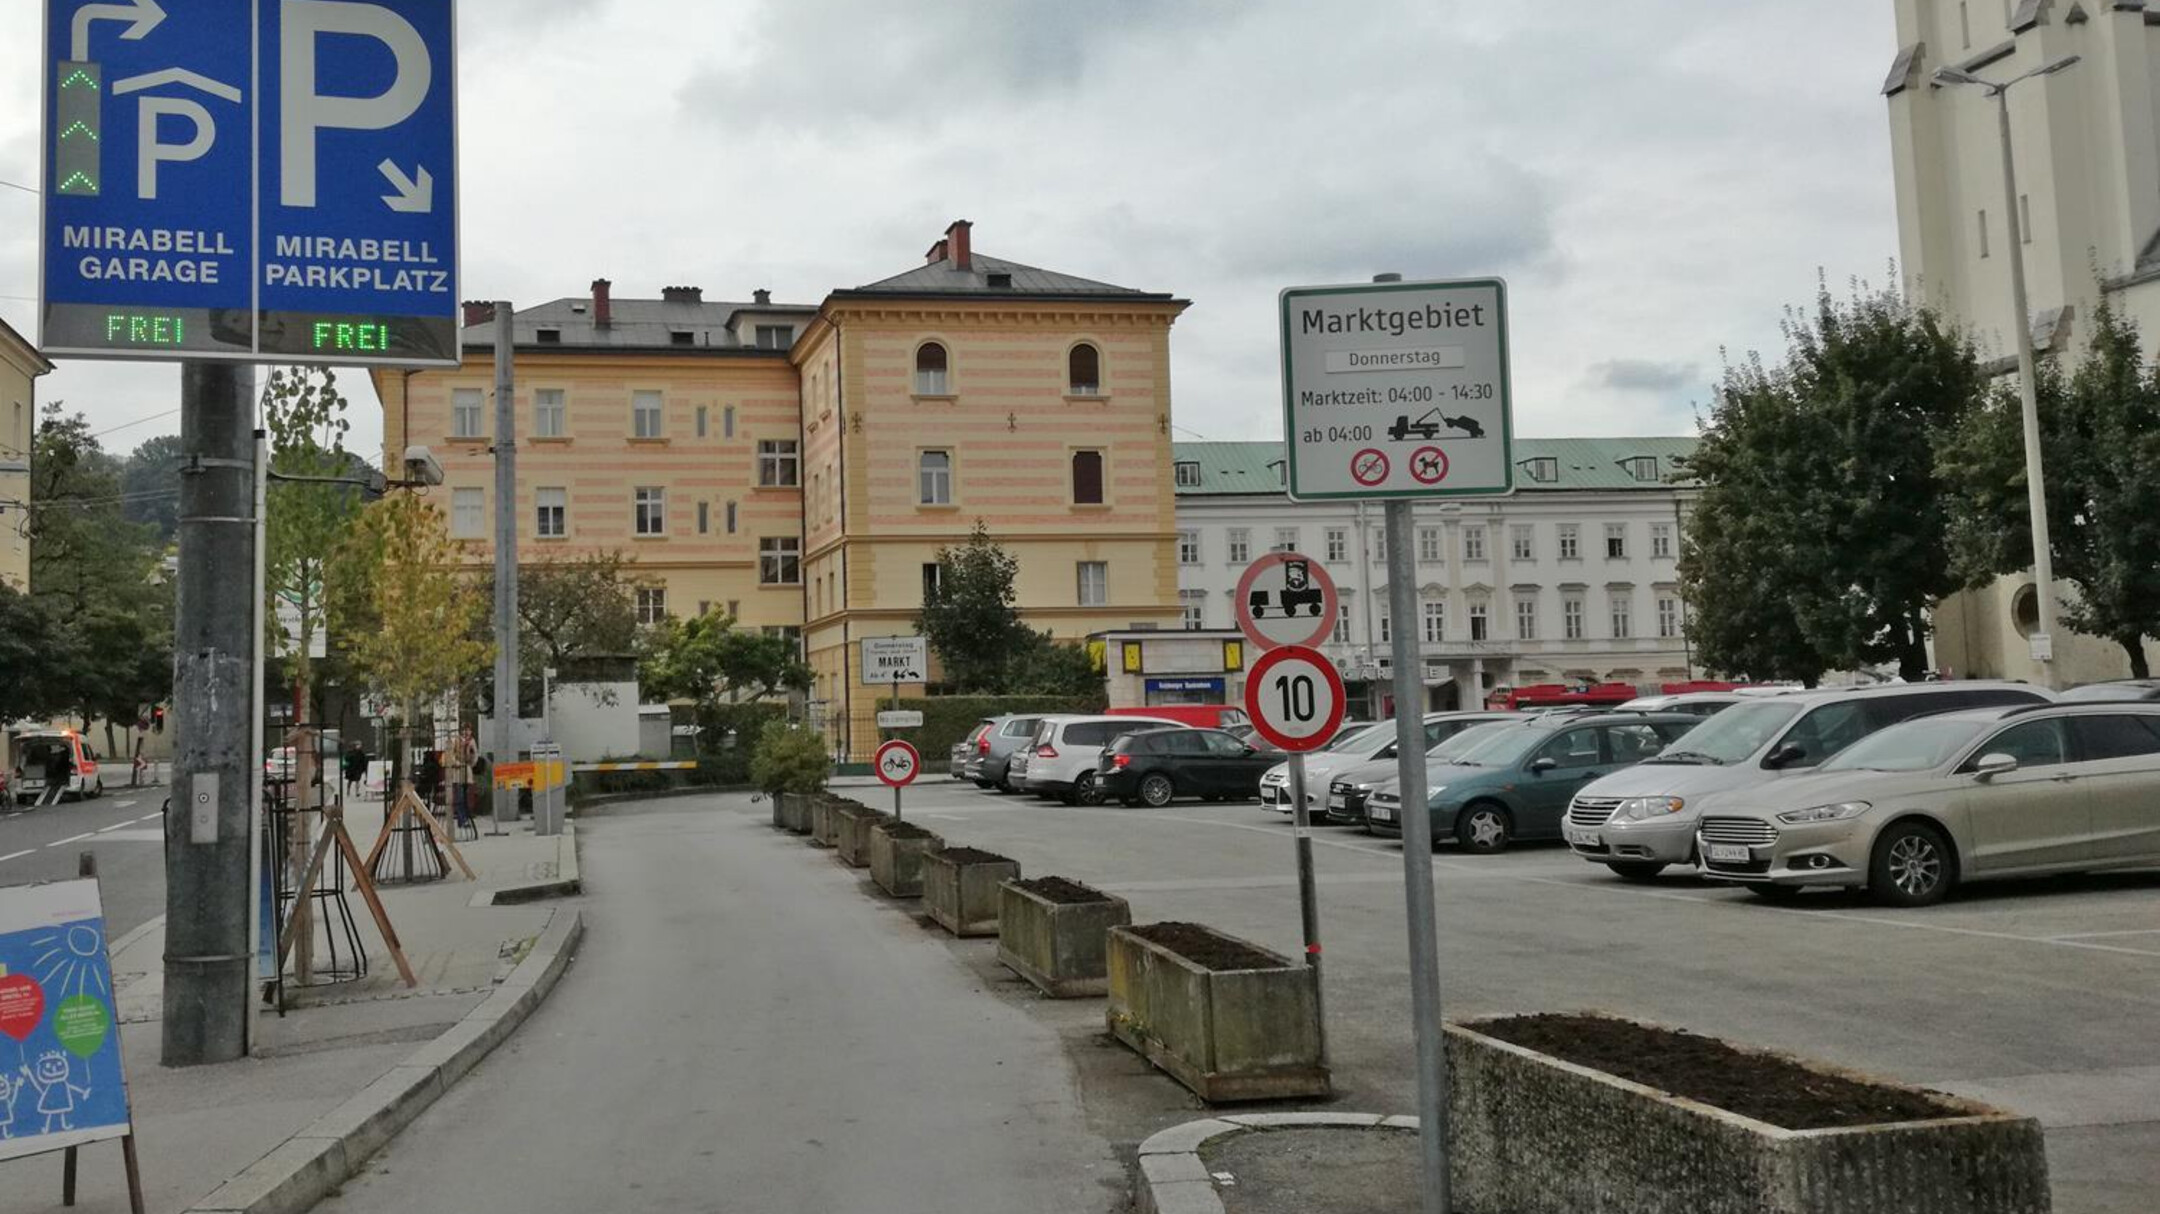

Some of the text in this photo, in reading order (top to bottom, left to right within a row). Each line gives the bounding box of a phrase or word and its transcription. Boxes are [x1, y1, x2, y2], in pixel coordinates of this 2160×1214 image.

[280, 0, 432, 207] P
[138, 96, 216, 199] P
[63, 226, 234, 254] MIRABELL
[276, 235, 438, 263] MIRABELL
[79, 255, 219, 284] GARAGE
[266, 264, 448, 293] PARKPLATZ
[107, 315, 183, 344] FREI
[1302, 302, 1485, 336] Marktgebiet
[313, 322, 389, 350] FREI
[1349, 351, 1440, 366] Donnerstag
[1301, 388, 1382, 406] Marktzeit:
[1388, 386, 1432, 402] 04:00
[1451, 383, 1493, 400] 14:30
[1303, 426, 1372, 443] ab 04:00
[878, 656, 910, 667] MARKT
[1275, 675, 1315, 722] 10
